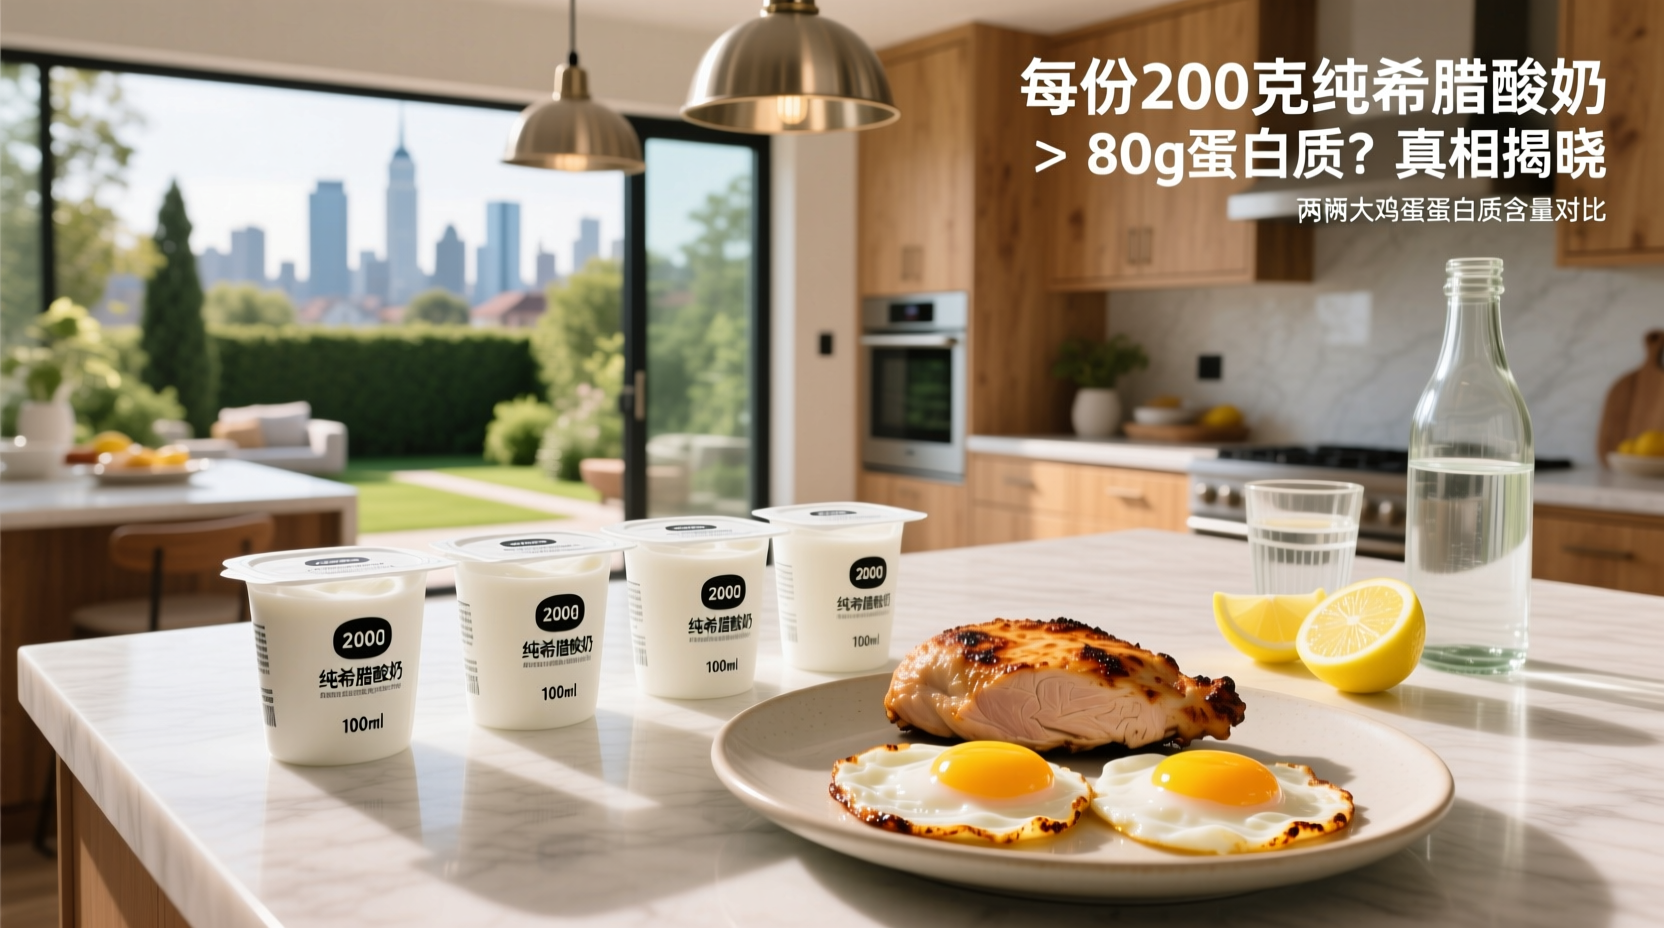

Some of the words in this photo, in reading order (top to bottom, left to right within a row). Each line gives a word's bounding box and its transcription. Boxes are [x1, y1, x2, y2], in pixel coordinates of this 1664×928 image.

[708, 584, 742, 601] 2000
[543, 604, 579, 622] 2000
[342, 628, 386, 649] 2000
[706, 657, 738, 673] 100ml
[541, 683, 577, 701] 100ml
[342, 712, 384, 734] 100ml
